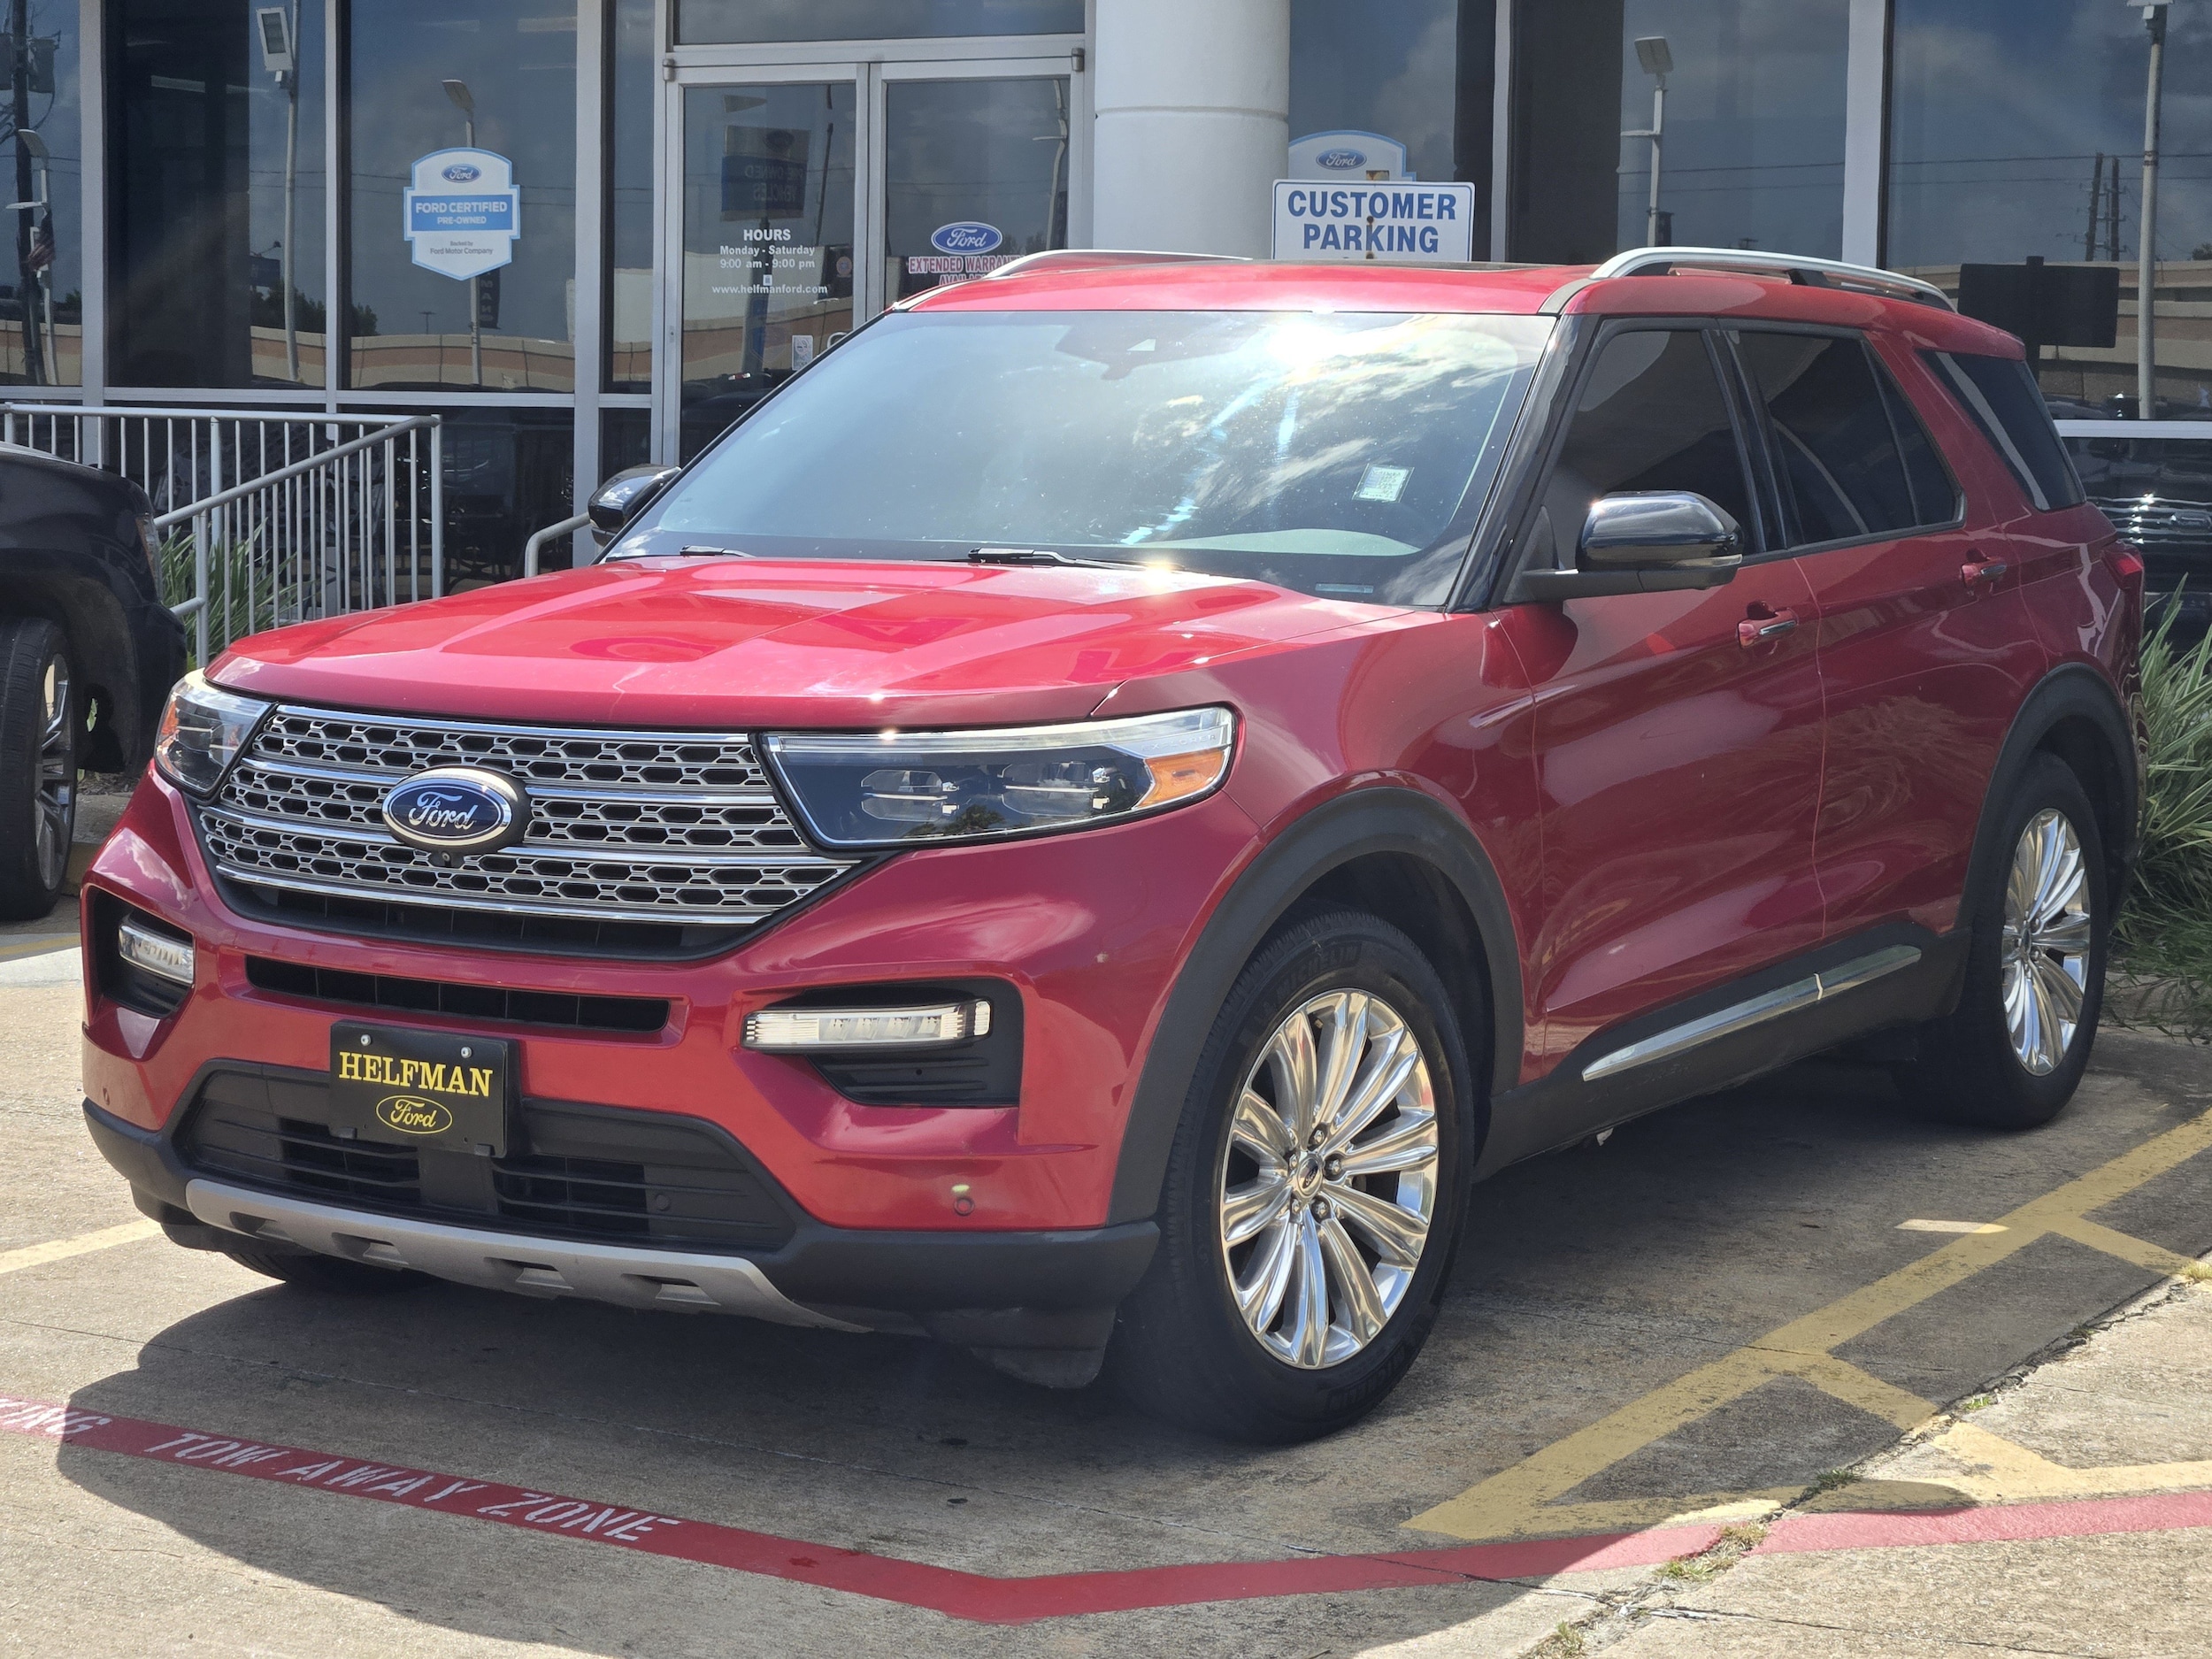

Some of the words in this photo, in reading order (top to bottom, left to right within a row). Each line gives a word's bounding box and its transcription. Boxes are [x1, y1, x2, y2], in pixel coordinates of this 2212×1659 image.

[1325, 152, 1356, 166] Ford
[449, 166, 473, 180] Ford
[415, 202, 447, 213] FORD
[449, 202, 508, 213] CERTIFIED
[1287, 190, 1456, 219] CUSTOMER
[436, 216, 487, 225] PRE-OWNED
[743, 228, 791, 242] HOURS
[946, 227, 987, 248] Ford
[1303, 223, 1439, 253] PARKING
[719, 245, 760, 257] Monday
[768, 245, 816, 256] Saturday
[719, 258, 741, 269] 9:00
[772, 258, 795, 269] 9:00
[798, 261, 816, 270] pm
[910, 257, 963, 273] EXTENDED
[965, 256, 1024, 273] WARRAN
[711, 283, 829, 295] www.helfmanford.com
[1141, 733, 1217, 751] EXPLORER
[408, 791, 479, 830] Ford
[339, 1051, 493, 1097] HELFMAN
[390, 1099, 437, 1128] Ford
[143, 1432, 290, 1467] TOW
[275, 1460, 488, 1502] AWAY
[477, 1492, 681, 1541] ZONE
